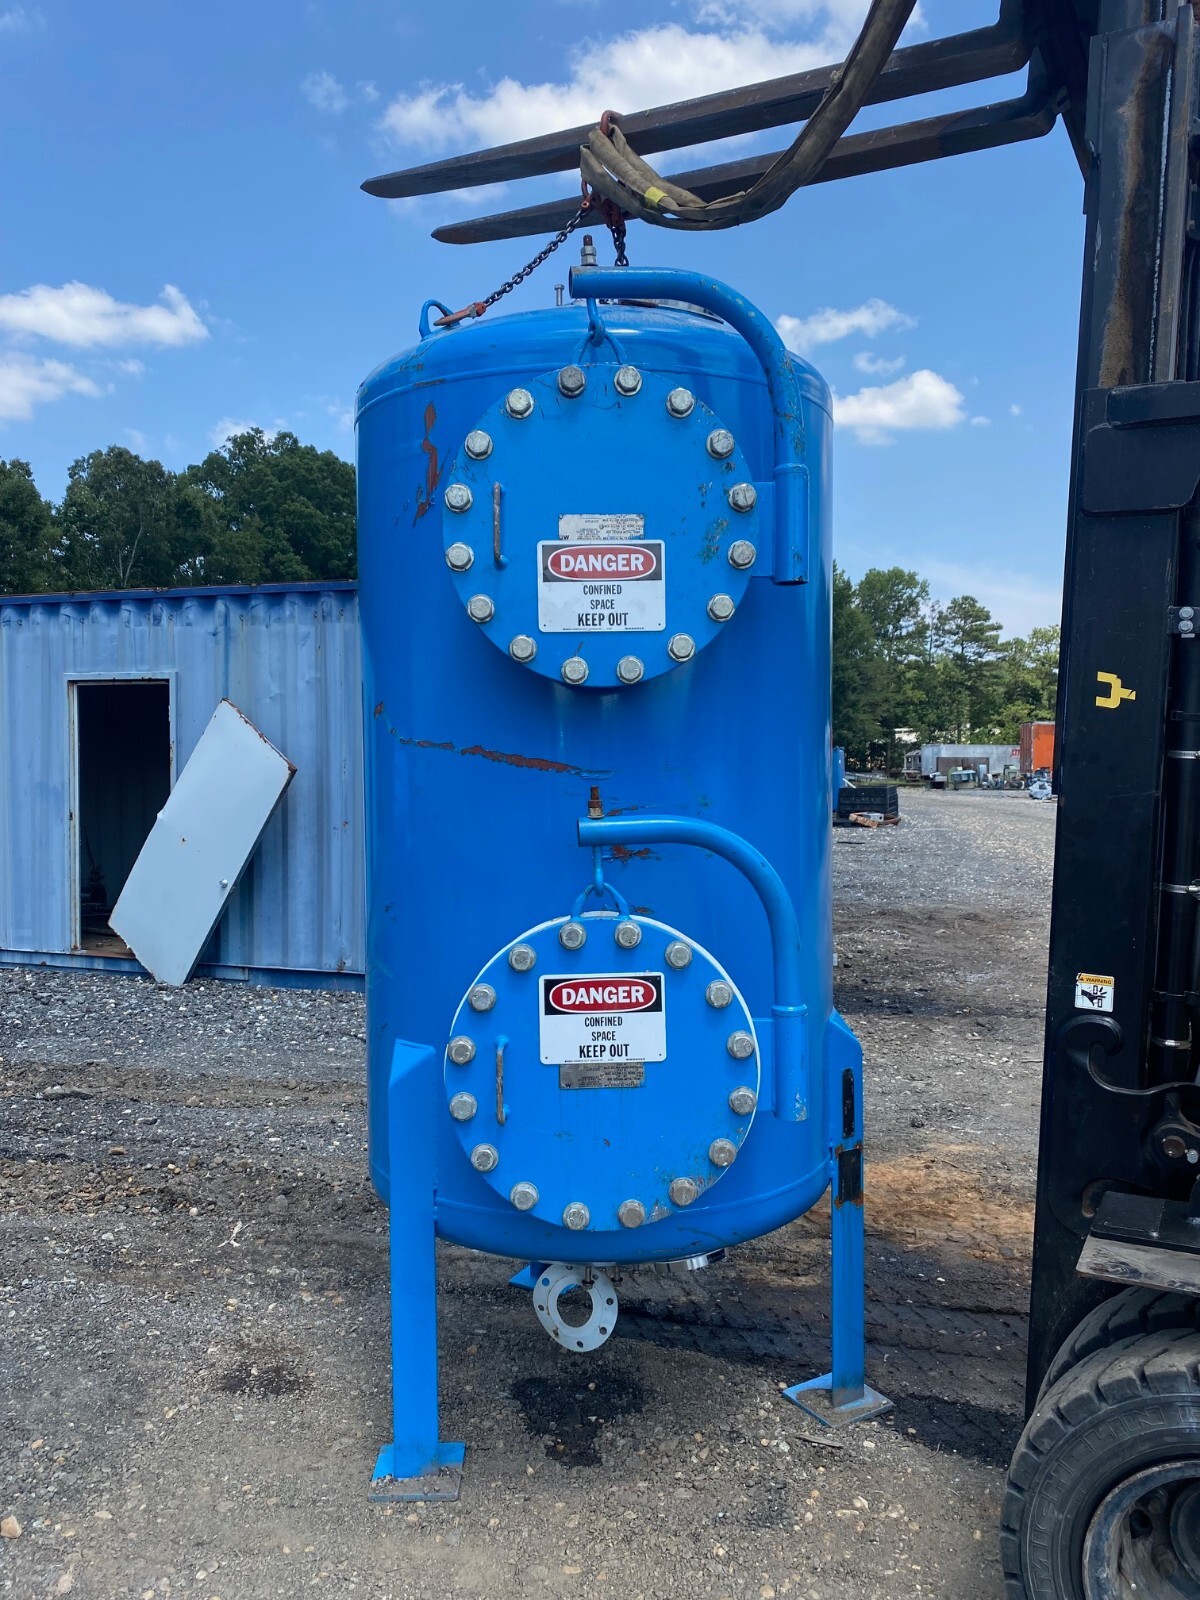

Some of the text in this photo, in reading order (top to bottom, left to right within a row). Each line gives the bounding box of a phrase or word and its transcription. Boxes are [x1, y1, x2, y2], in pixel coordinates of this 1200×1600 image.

[560, 554, 644, 572] DANGER
[583, 584, 622, 595] CONFINED
[590, 599, 615, 609] SPACE
[578, 612, 629, 626] KEEP OUT
[562, 986, 644, 1005] DANGER
[584, 1016, 622, 1027] CONFINED
[591, 1031, 616, 1041] SPACE
[579, 1044, 629, 1058] KEEP OUT
[1032, 1406, 1165, 1592] MICHELIN
